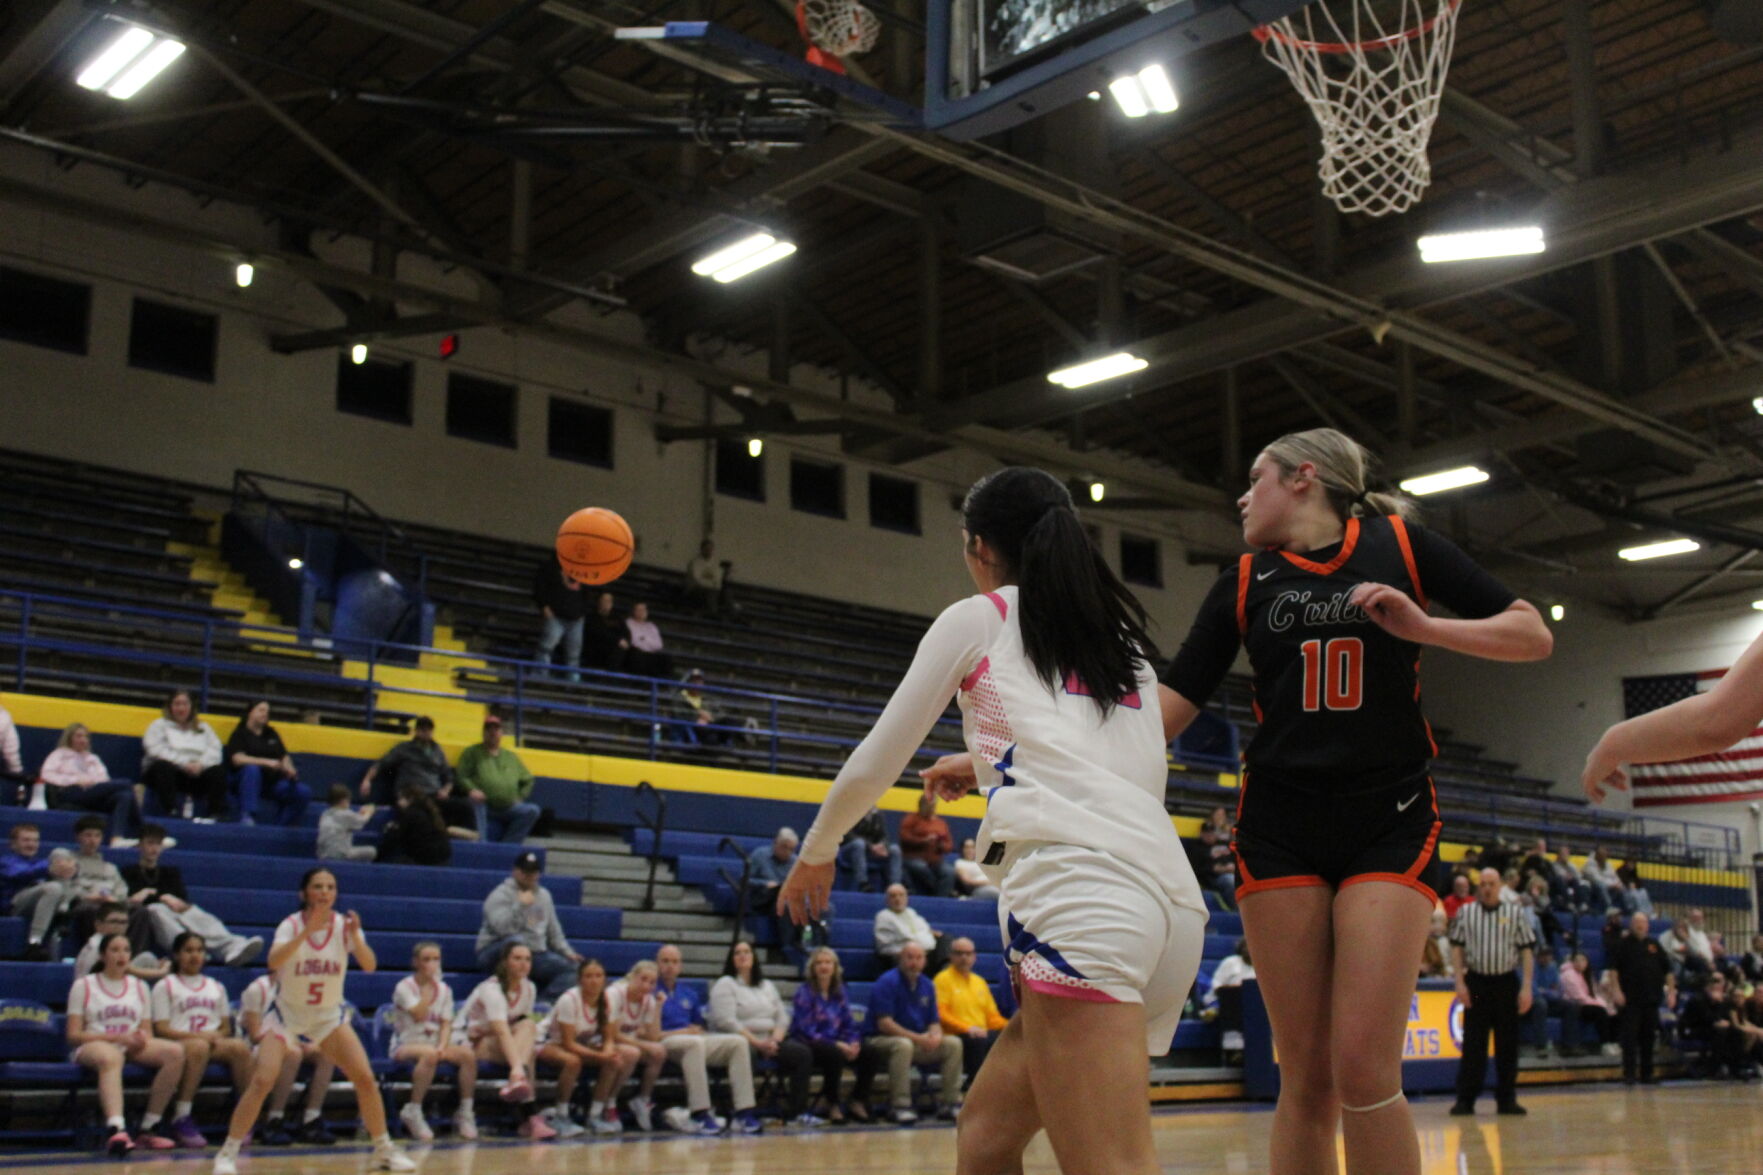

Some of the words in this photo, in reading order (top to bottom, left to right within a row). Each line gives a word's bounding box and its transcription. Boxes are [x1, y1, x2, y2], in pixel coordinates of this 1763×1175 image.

[1301, 637, 1364, 712] 10
[295, 958, 341, 976] LOGAN
[306, 982, 325, 1005] 5
